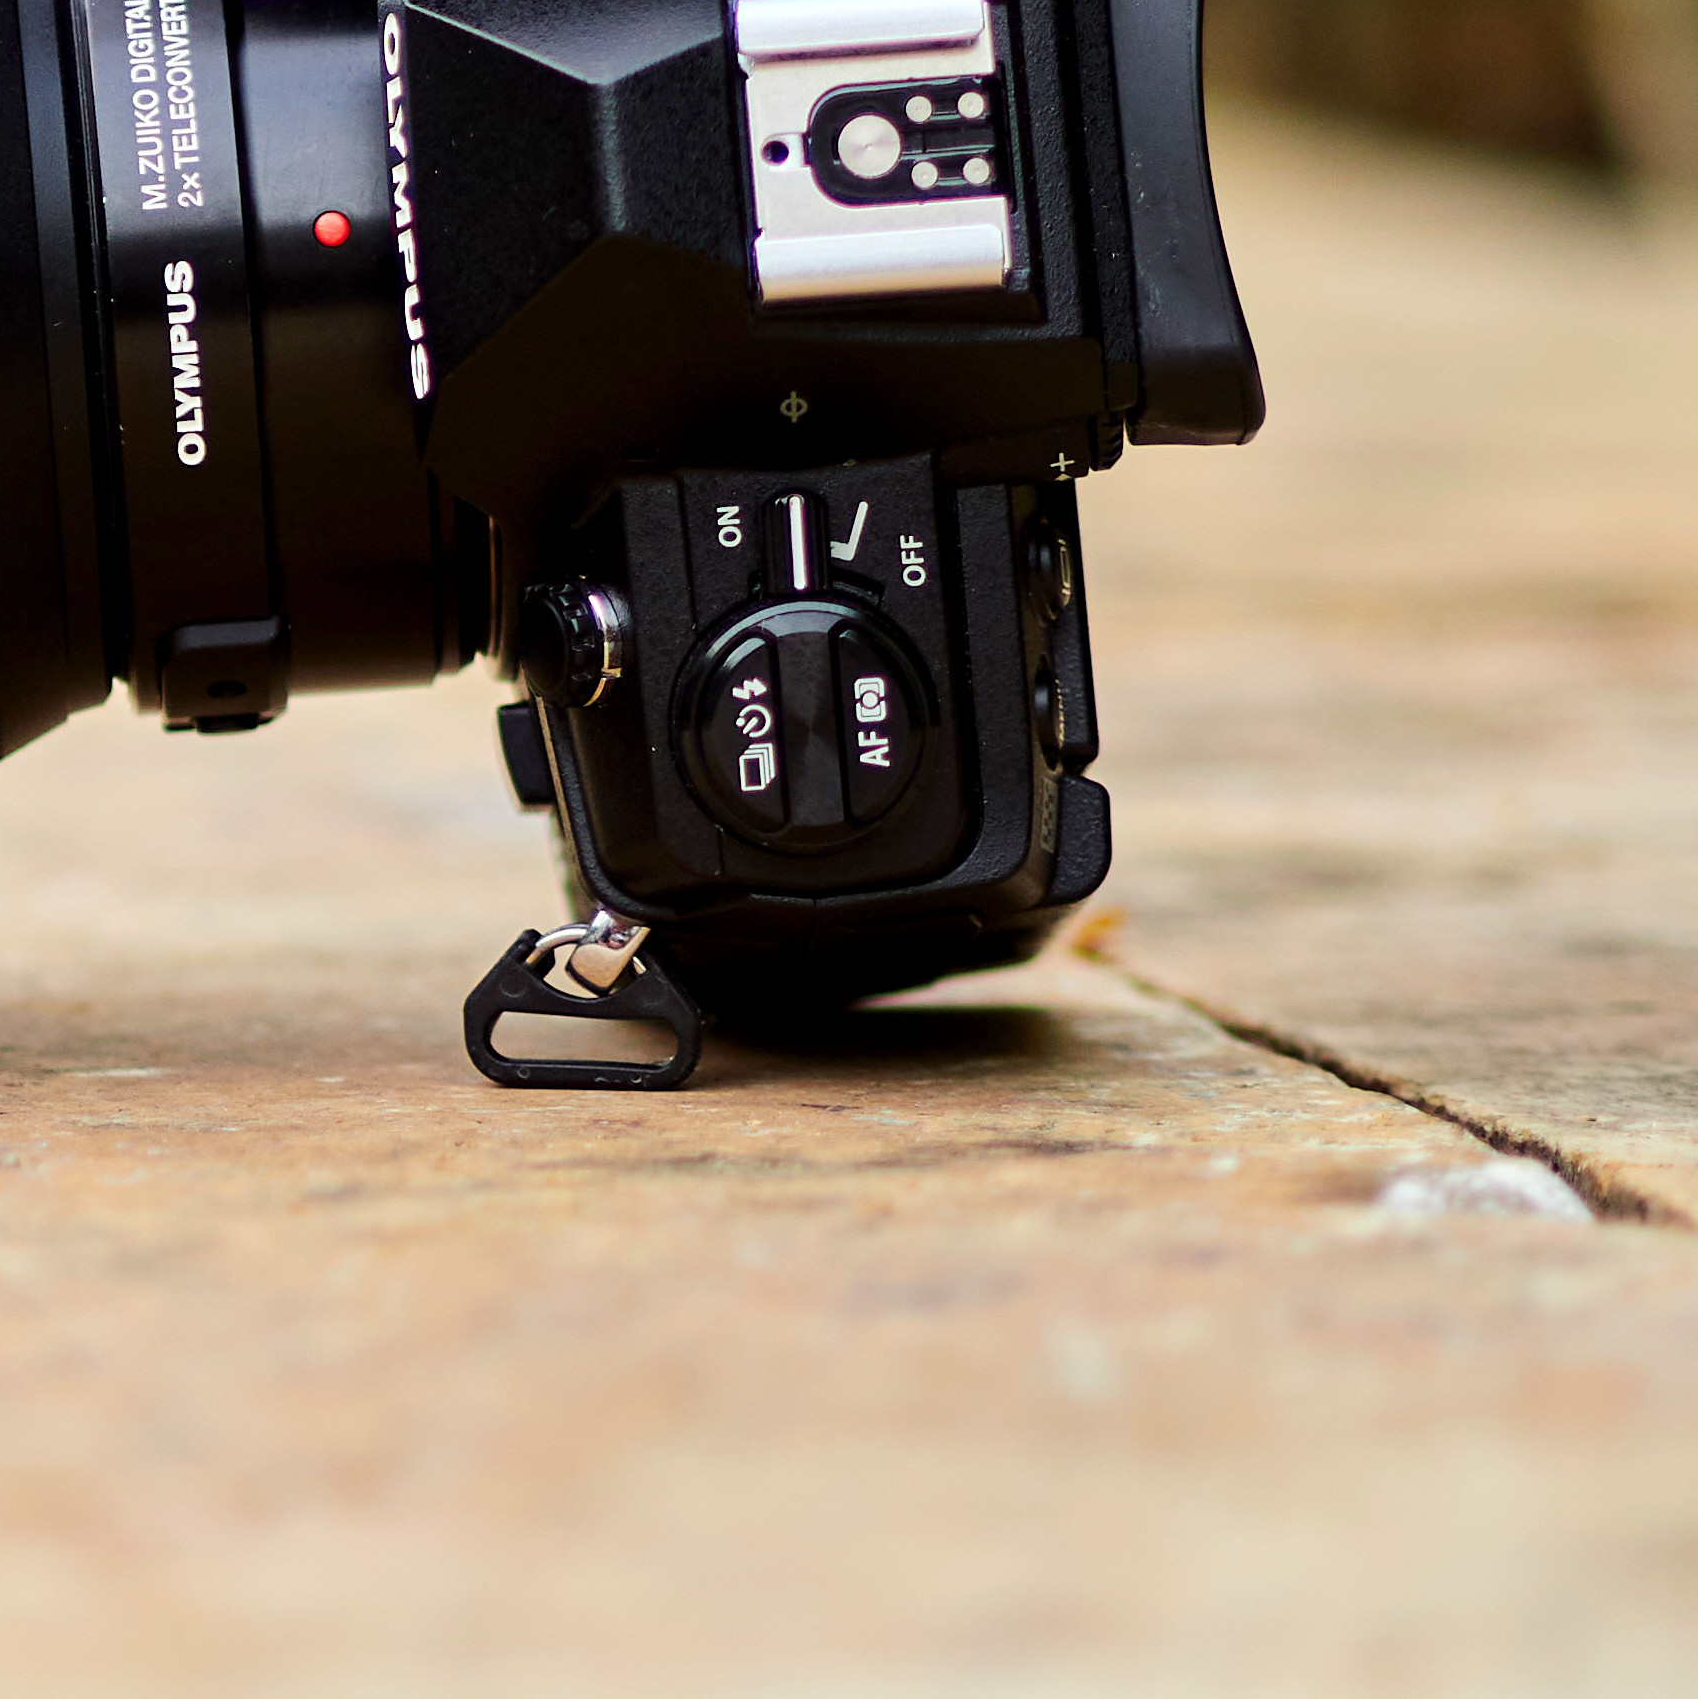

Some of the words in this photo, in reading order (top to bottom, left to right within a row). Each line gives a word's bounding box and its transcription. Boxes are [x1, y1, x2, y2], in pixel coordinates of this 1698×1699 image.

[134, 89, 168, 211] M.ZUIKO
[383, 12, 431, 400] OLYMPUS
[164, 260, 206, 467] OLYMPUS
[717, 505, 741, 548] ON
[900, 534, 926, 587] OFF
[858, 731, 890, 767] AF
